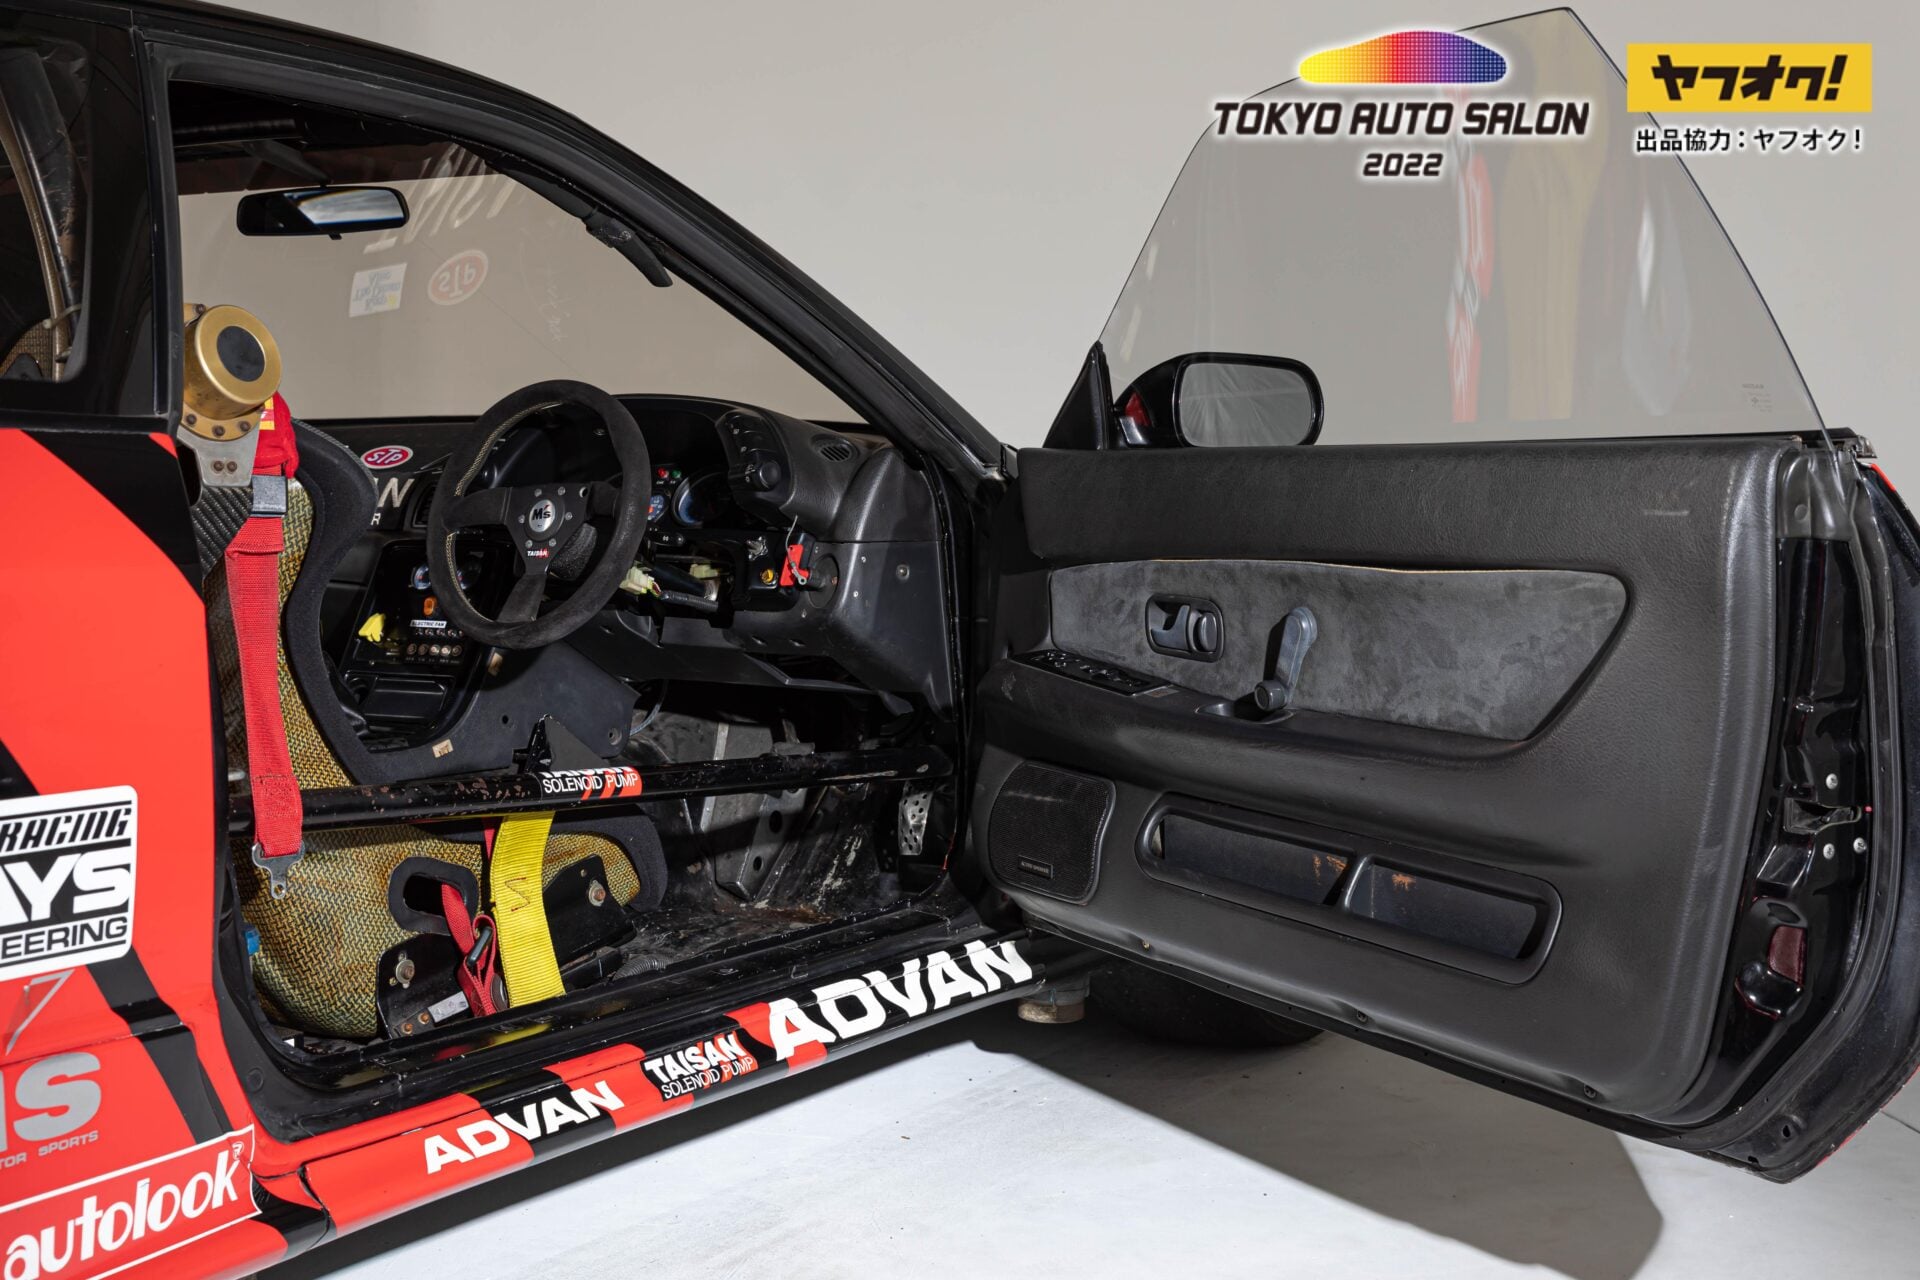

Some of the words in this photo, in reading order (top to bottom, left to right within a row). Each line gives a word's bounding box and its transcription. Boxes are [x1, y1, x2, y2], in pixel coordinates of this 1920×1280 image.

[367, 448, 403, 464] STP
[542, 775, 603, 794] SOLENOID
[606, 772, 639, 788] PUMP
[0, 807, 132, 852] RACING
[0, 916, 128, 960] EERING
[768, 939, 1034, 1062] ADVAN
[645, 1034, 747, 1082] TAISAN
[661, 1069, 721, 1100] SOLENOID
[723, 1057, 755, 1083] PUMP
[38, 1130, 99, 1157] SPORTS
[424, 1080, 626, 1175] ADVAN
[4, 1150, 241, 1280] autolook
